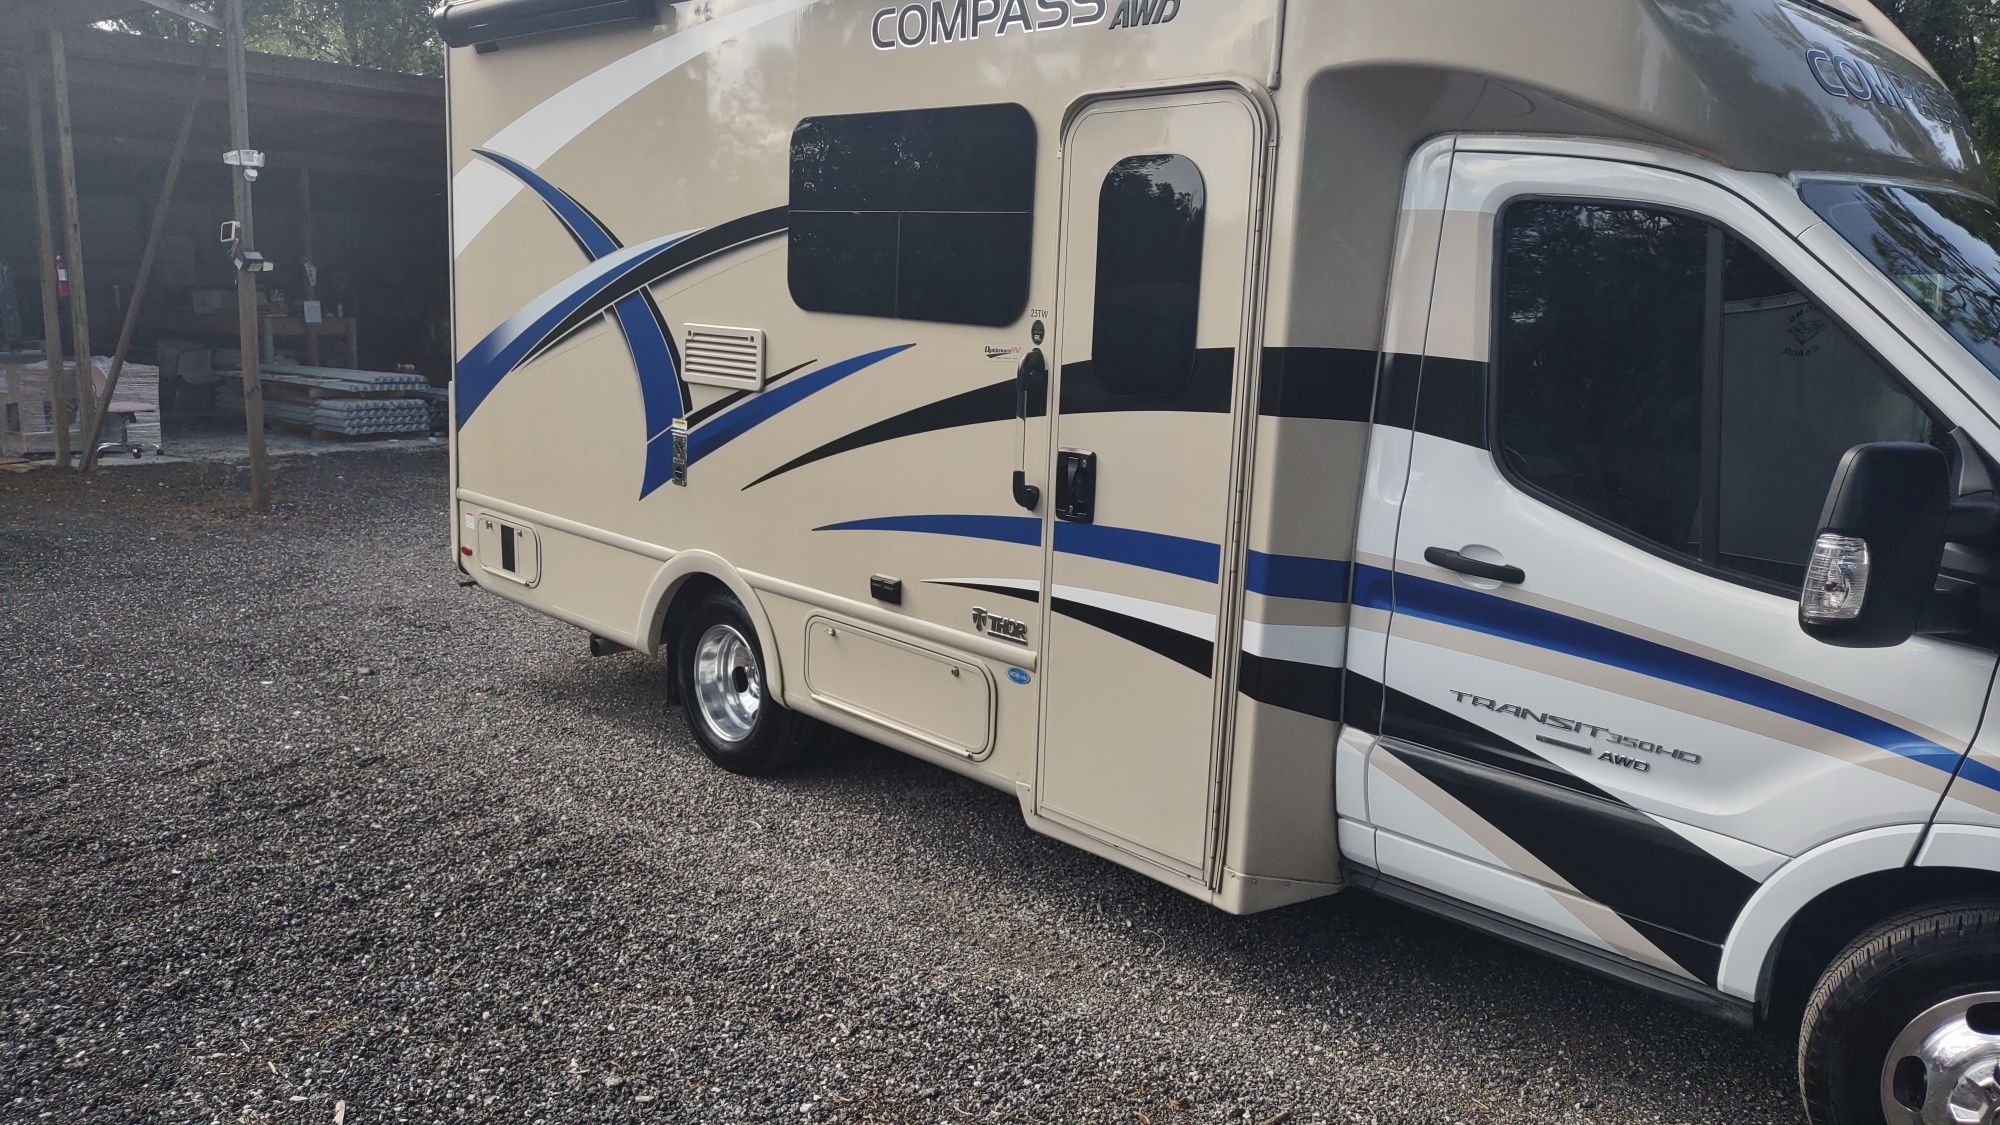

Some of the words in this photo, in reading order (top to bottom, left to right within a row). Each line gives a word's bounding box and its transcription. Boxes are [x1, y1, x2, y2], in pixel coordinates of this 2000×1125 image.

[871, 0, 1107, 50] COMPASS
[1108, 0, 1181, 30] AWD
[1030, 309, 1049, 318] 23TW
[987, 613, 1028, 642] THOR
[1450, 688, 1609, 738] TRANSIT
[1598, 750, 1651, 773] AWD
